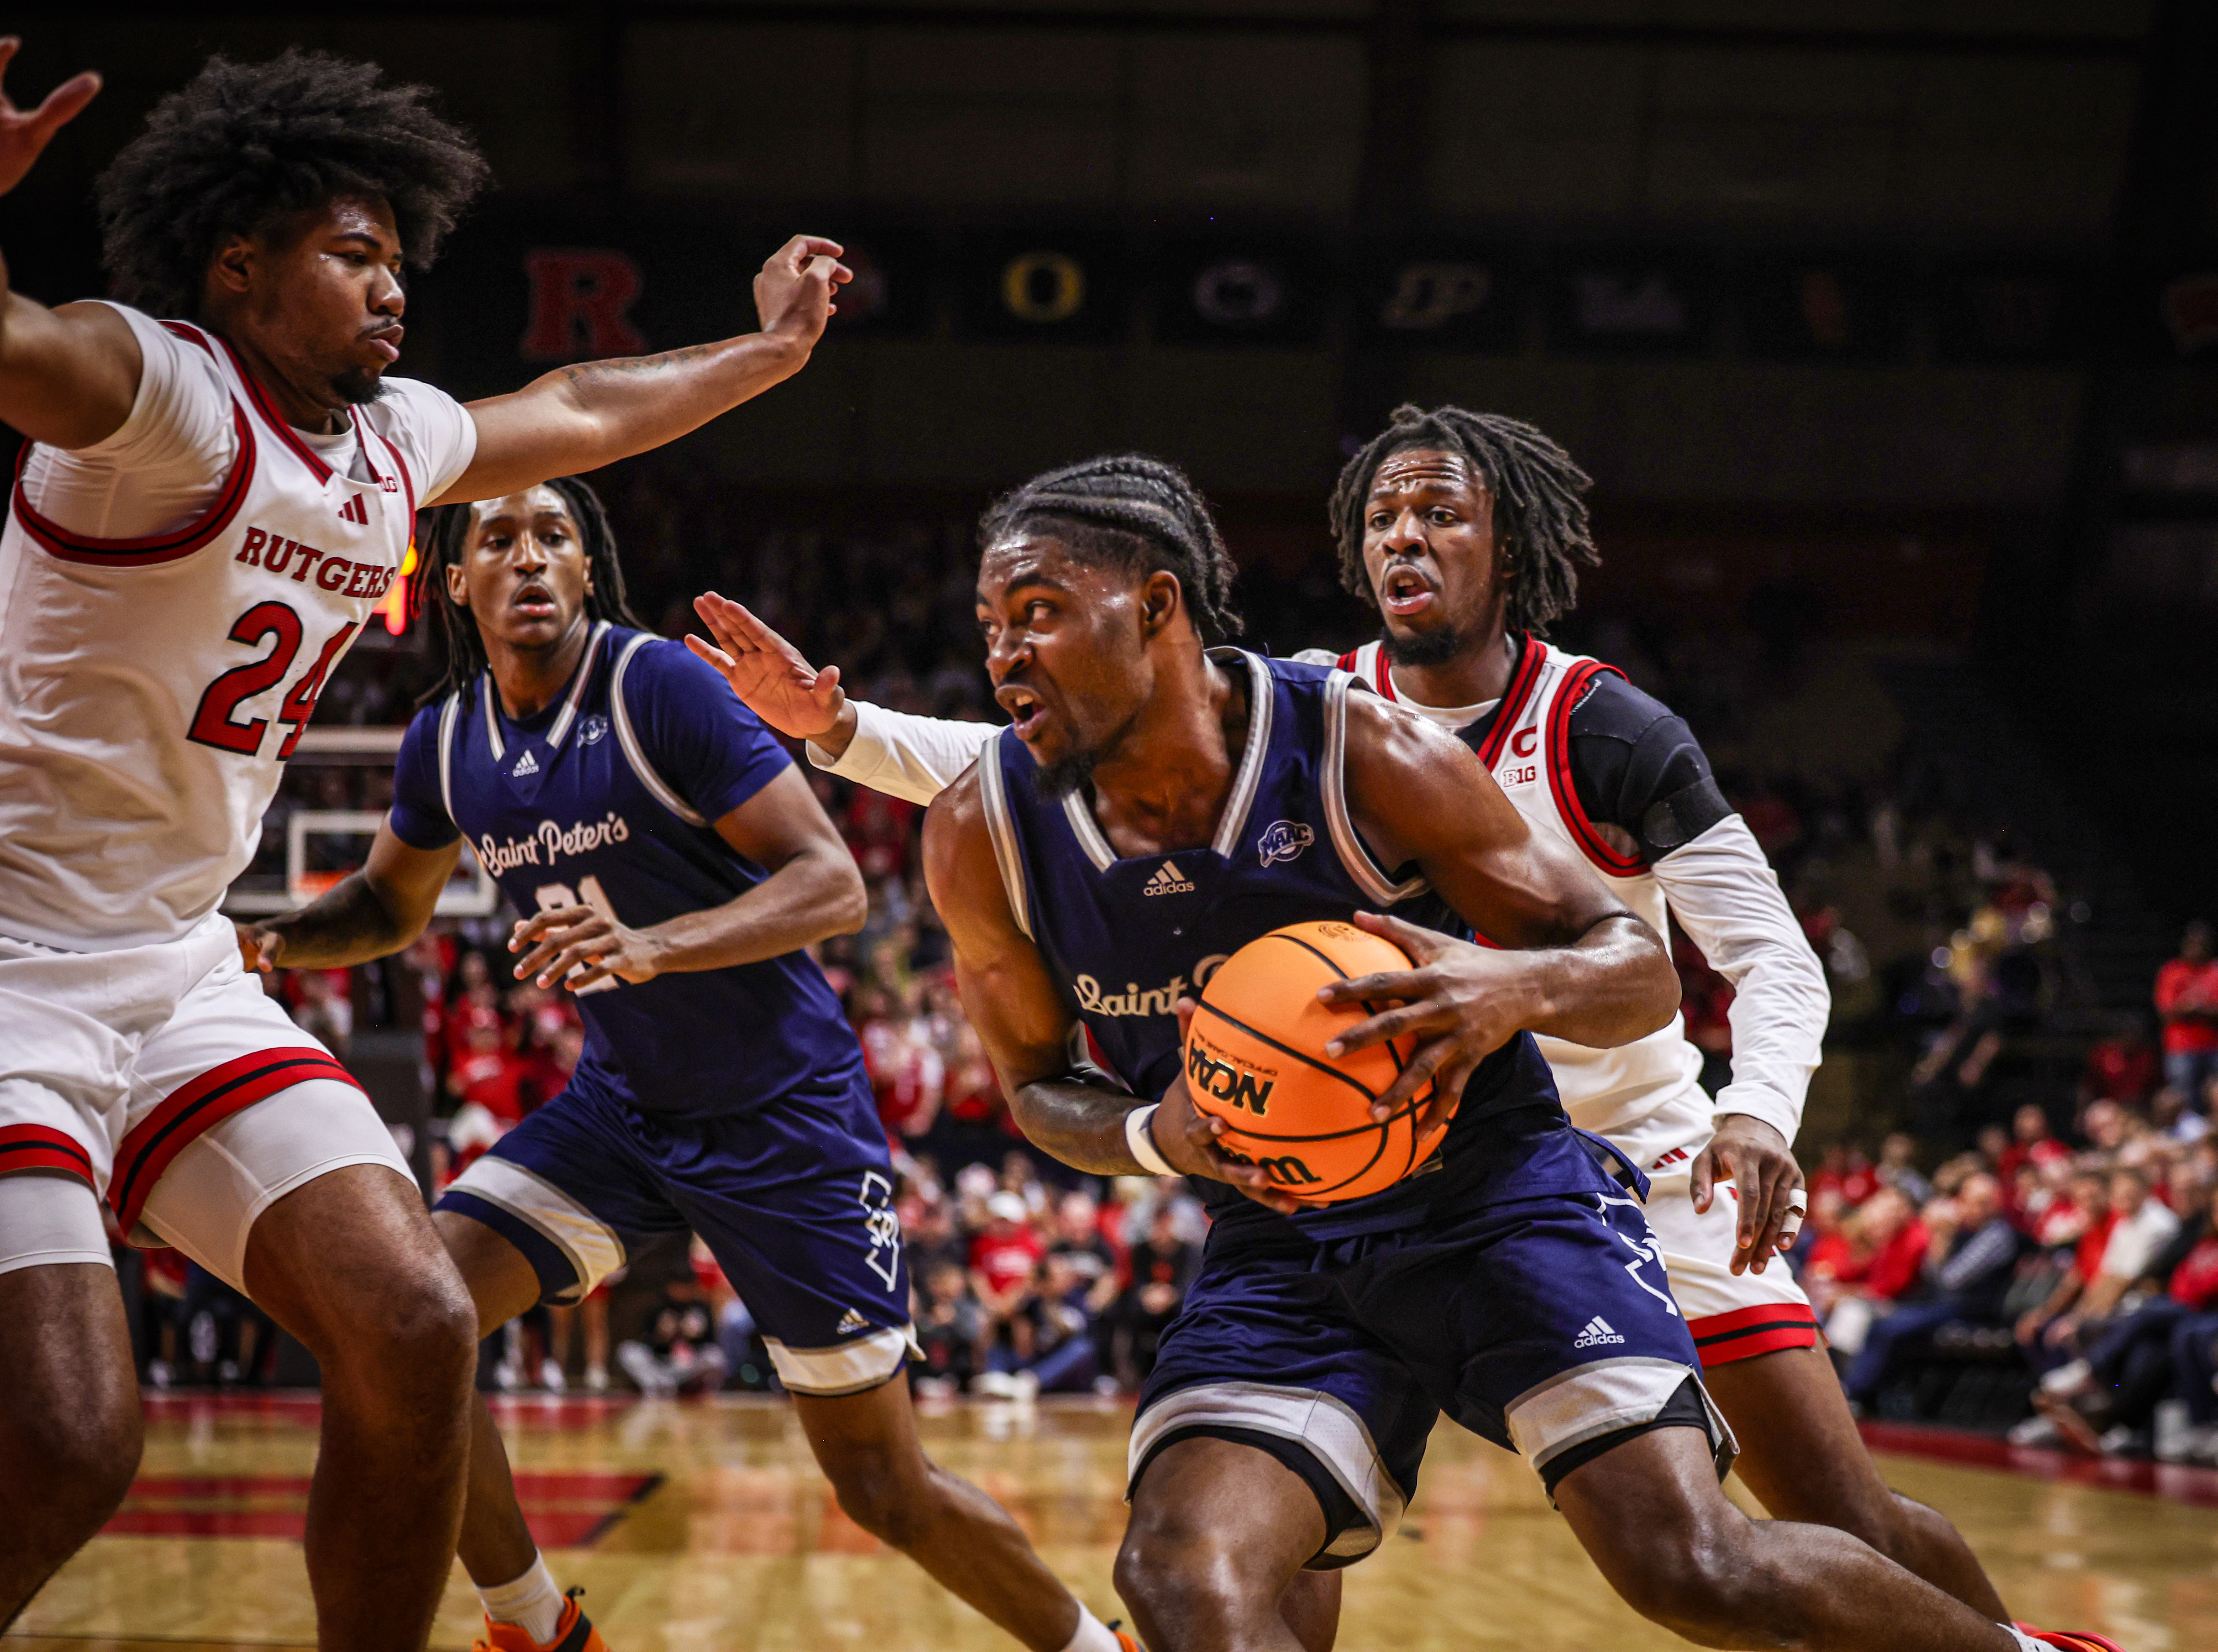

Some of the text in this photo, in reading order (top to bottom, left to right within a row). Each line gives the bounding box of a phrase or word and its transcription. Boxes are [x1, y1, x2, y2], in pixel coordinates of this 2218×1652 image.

[523, 249, 642, 360] R
[1002, 253, 1084, 322] O
[235, 526, 396, 598] RUTGERS
[187, 600, 358, 762] 24
[1512, 723, 1537, 758] C
[481, 811, 630, 878] Saint Peter's
[1261, 827, 1309, 863] MAAC
[1143, 881, 1195, 897] adidas
[1073, 975, 1188, 1017] Saint
[1189, 1038, 1275, 1118] NCAA
[1574, 1334, 1625, 1349] adidas
